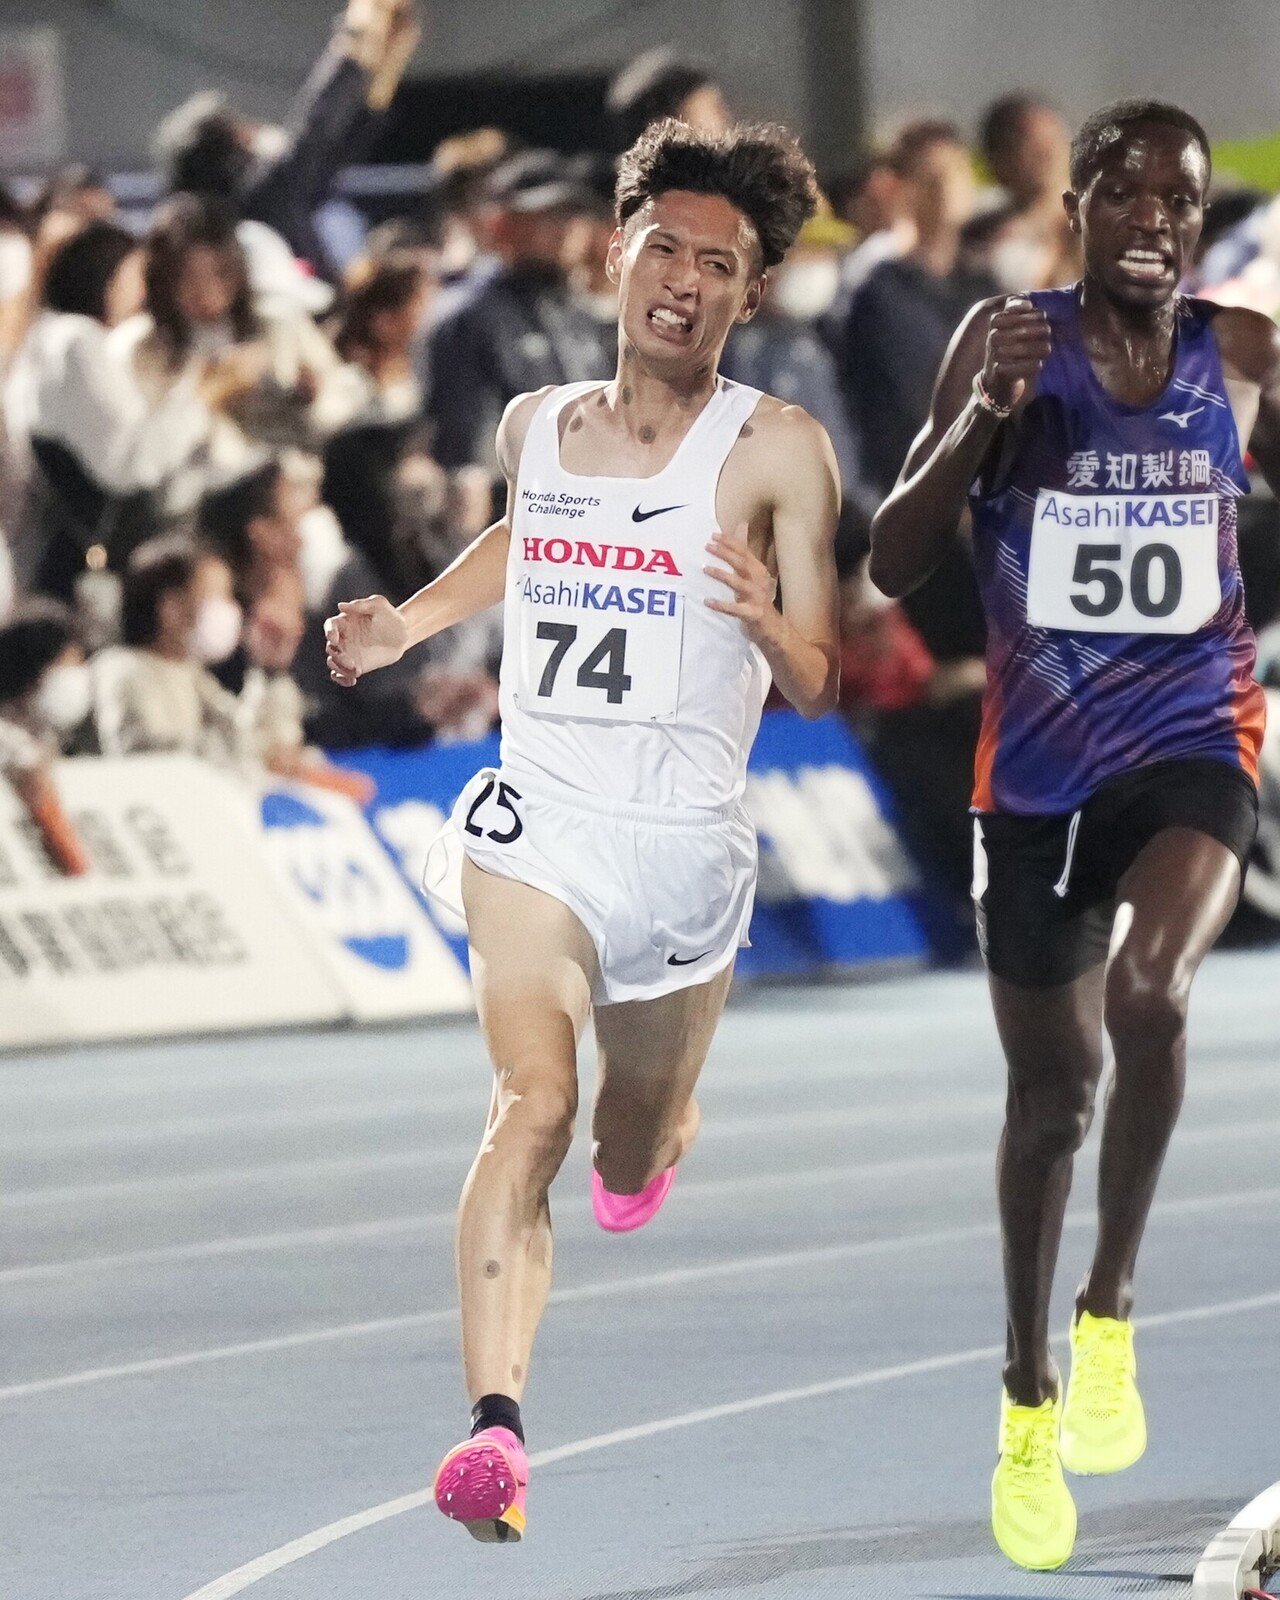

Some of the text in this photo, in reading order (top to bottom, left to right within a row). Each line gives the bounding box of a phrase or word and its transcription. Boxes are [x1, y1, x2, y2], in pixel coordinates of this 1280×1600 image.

[1066, 450, 1211, 490] 愛知製鋼
[522, 489, 601, 507] Honda Sports
[528, 503, 586, 519] Challenge
[1040, 497, 1213, 527] AsahiKASEI
[523, 537, 683, 577] HONDA
[522, 577, 677, 617] AsahiKASEI
[1069, 543, 1183, 618] 50
[536, 621, 632, 704] 74
[464, 771, 523, 844] 25
